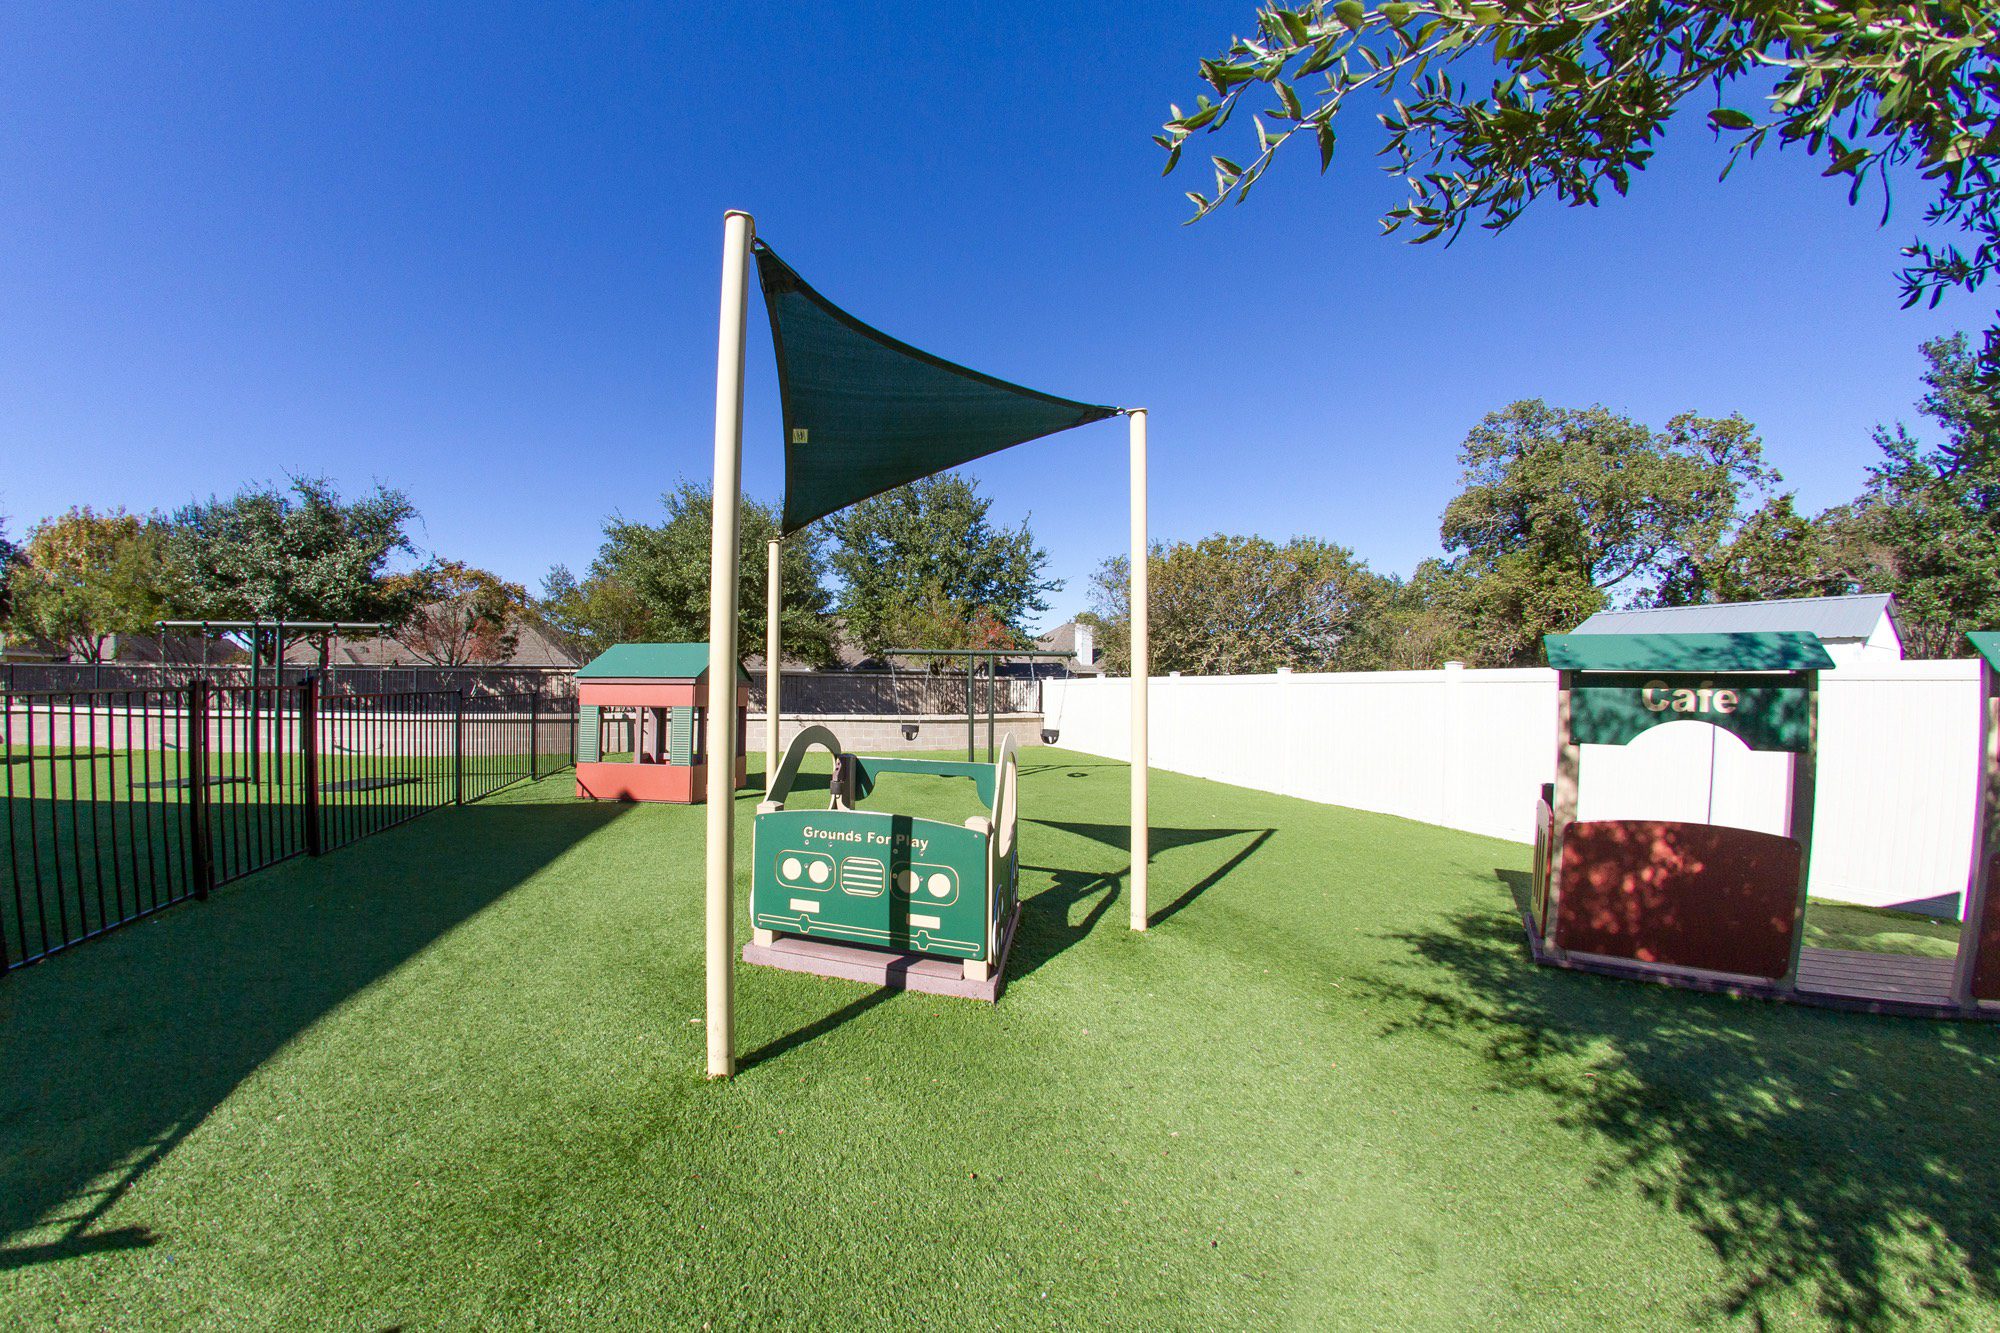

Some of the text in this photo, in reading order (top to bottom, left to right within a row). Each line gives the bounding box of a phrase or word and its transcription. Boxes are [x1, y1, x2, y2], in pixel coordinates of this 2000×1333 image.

[1641, 680, 1739, 714] Cafe
[803, 826, 929, 851] Grounds For Play
